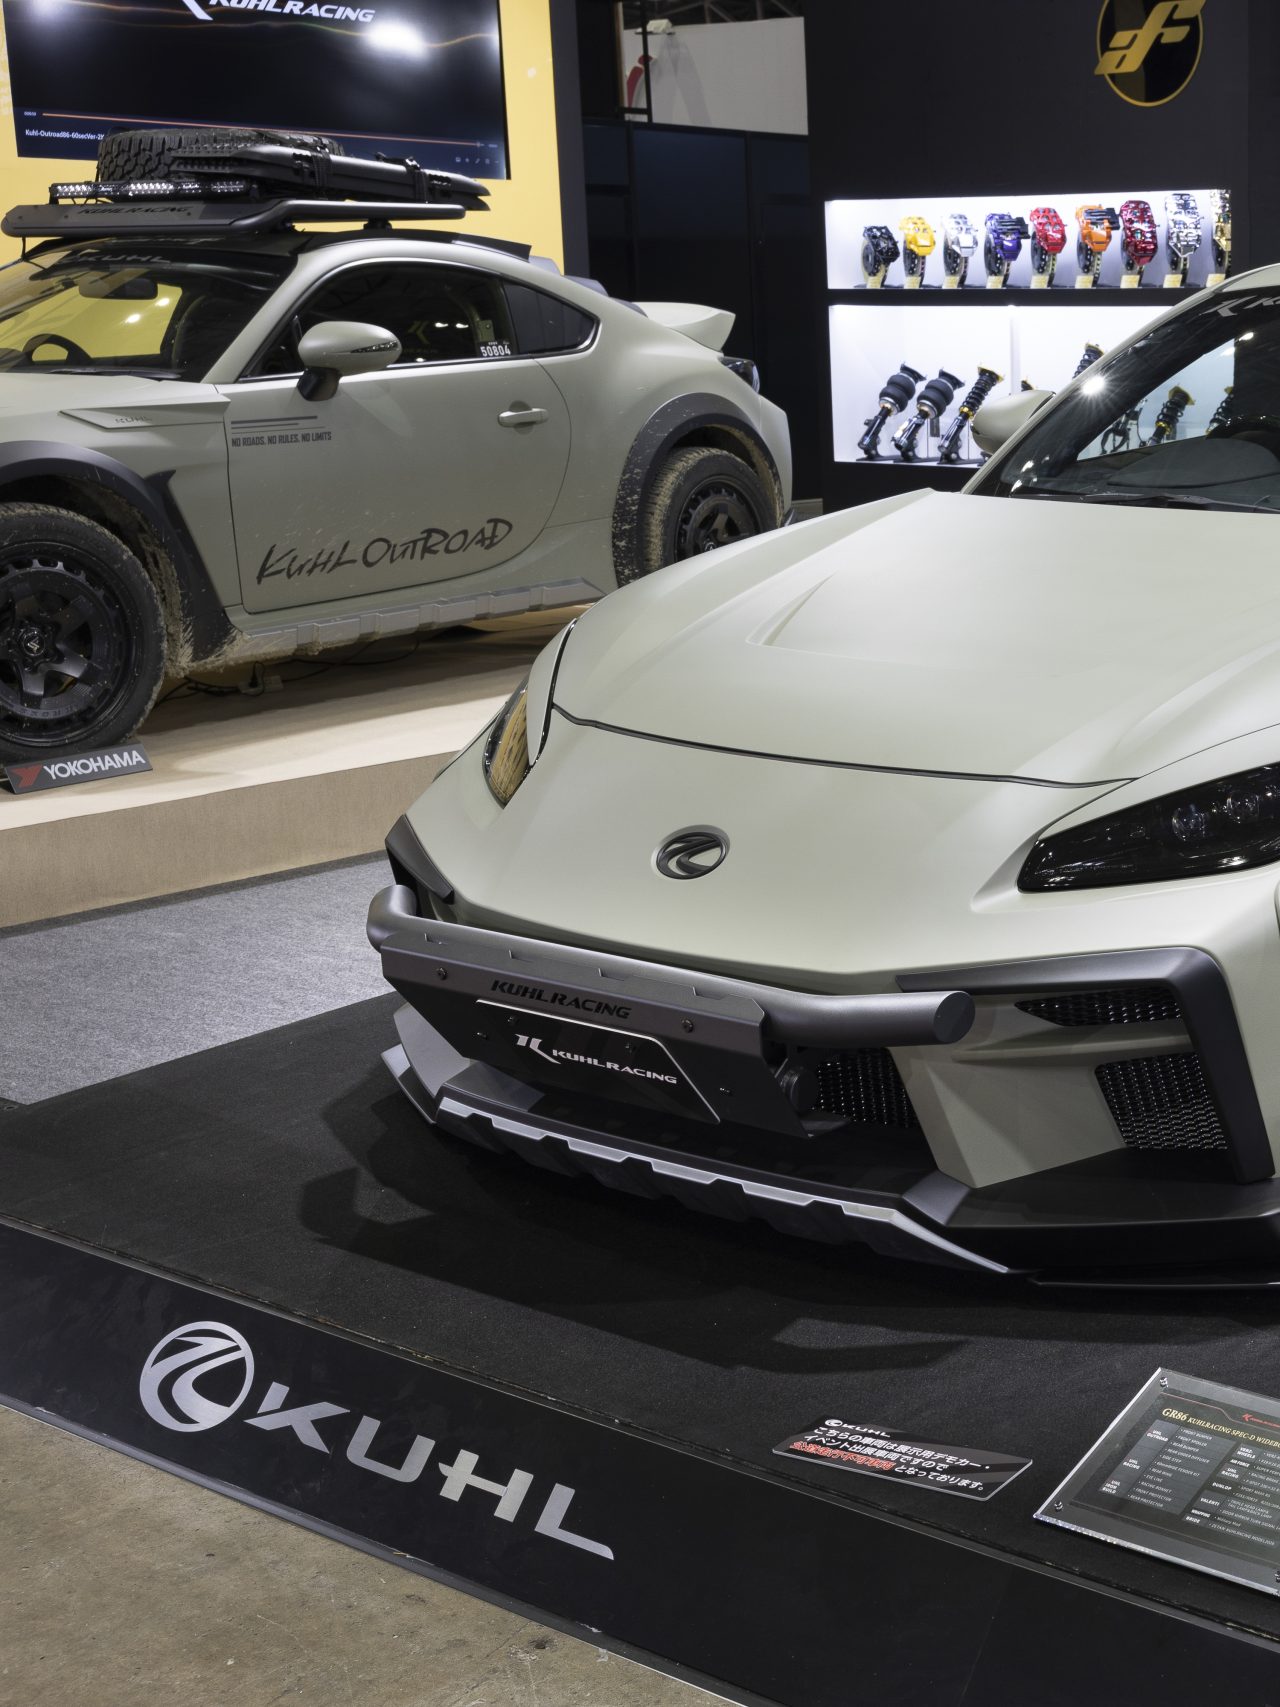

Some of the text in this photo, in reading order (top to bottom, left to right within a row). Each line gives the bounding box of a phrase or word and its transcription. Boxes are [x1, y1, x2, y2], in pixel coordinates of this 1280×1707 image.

[480, 345, 511, 357] 50804
[231, 437, 241, 447] NO
[242, 436, 267, 446] ROADS.
[267, 435, 277, 445] NO
[301, 433, 311, 442] NO
[311, 431, 332, 441] LIMITS
[43, 750, 146, 780] YOKOHAMA
[843, 1424, 891, 1438] KUHL
[1162, 1408, 1188, 1421] GR86
[1187, 1418, 1231, 1434] KUHLRACING
[1230, 1430, 1256, 1440] SPEC-D
[804, 1435, 949, 1471] イベント出展車両ですので
[244, 1382, 614, 1560] KUHL
[894, 1465, 984, 1491] となっております。
[1212, 1482, 1232, 1490] DUNLOP
